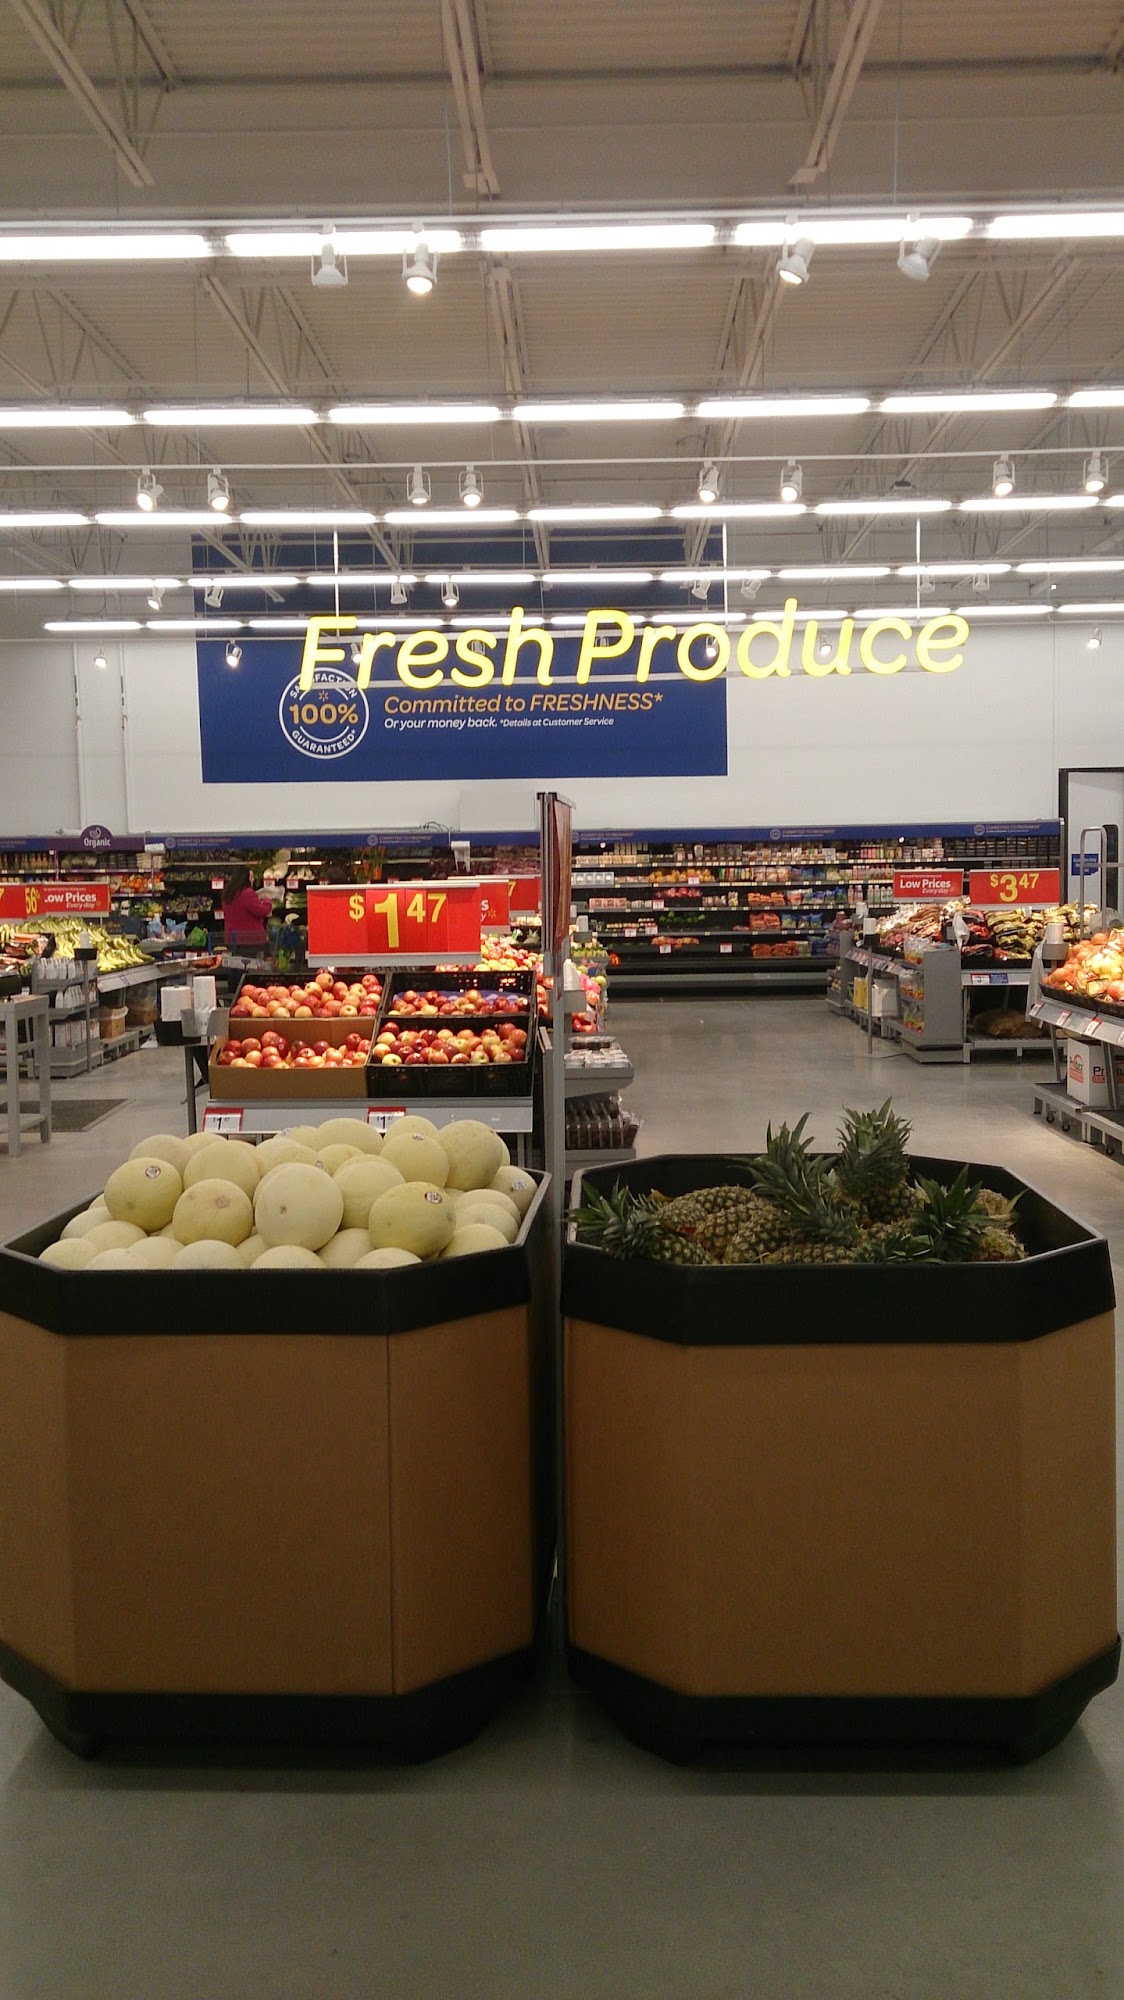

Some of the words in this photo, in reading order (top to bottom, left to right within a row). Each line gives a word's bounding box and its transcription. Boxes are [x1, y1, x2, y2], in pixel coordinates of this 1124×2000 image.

[300, 607, 554, 690] Fresh
[576, 597, 970, 684] Produce
[384, 694, 501, 713] Committed
[505, 695, 526, 712] to
[289, 703, 358, 725] 100%
[384, 718, 399, 728] Or
[399, 719, 426, 731] your
[427, 719, 466, 731] money
[467, 716, 498, 728] back.
[532, 718, 542, 726] at
[542, 718, 583, 727] Customer
[583, 716, 615, 726] Service
[83, 838, 111, 849] Organic
[900, 879, 921, 889] Low
[922, 878, 951, 889] Prices
[65, 891, 97, 903] Prices
